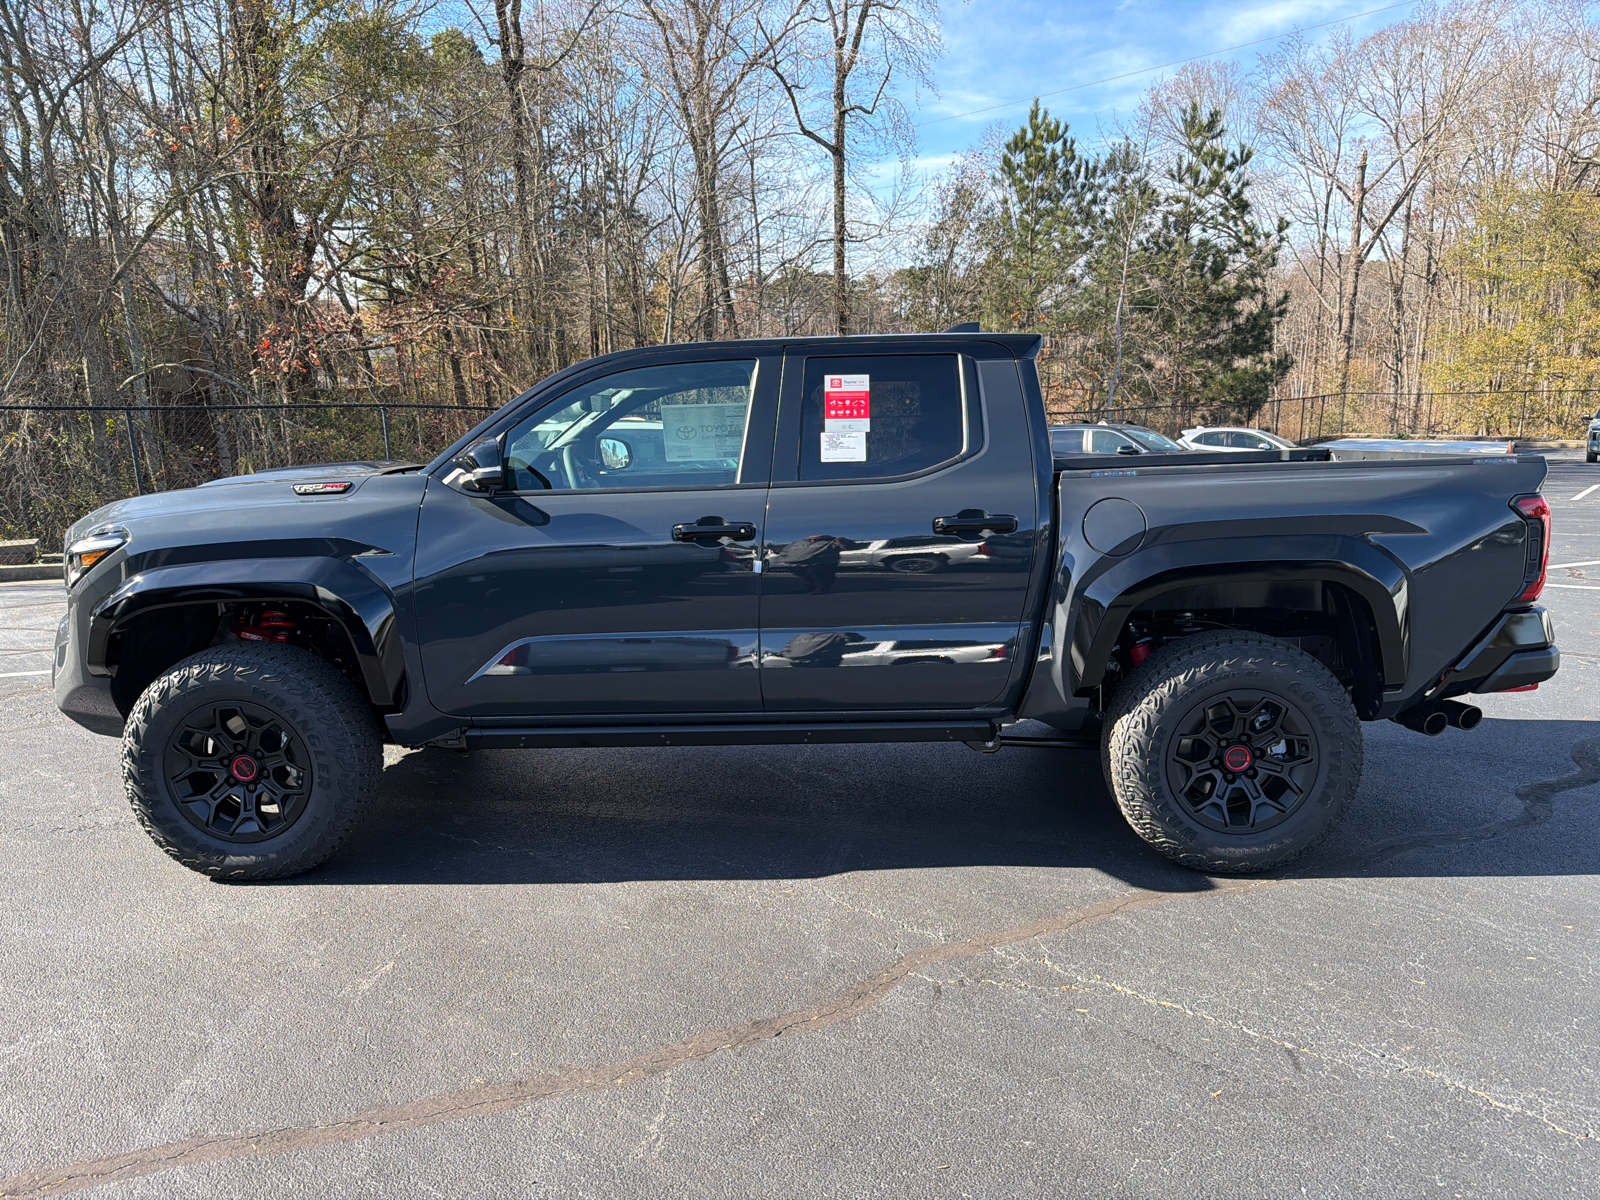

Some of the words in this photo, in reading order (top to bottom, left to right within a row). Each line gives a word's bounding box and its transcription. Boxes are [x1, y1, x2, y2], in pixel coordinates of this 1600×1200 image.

[699, 424, 741, 433] TOYOTA
[293, 484, 323, 492] TRD
[251, 685, 332, 790] WRANGLER
[1147, 725, 1200, 844] WRANGLER
